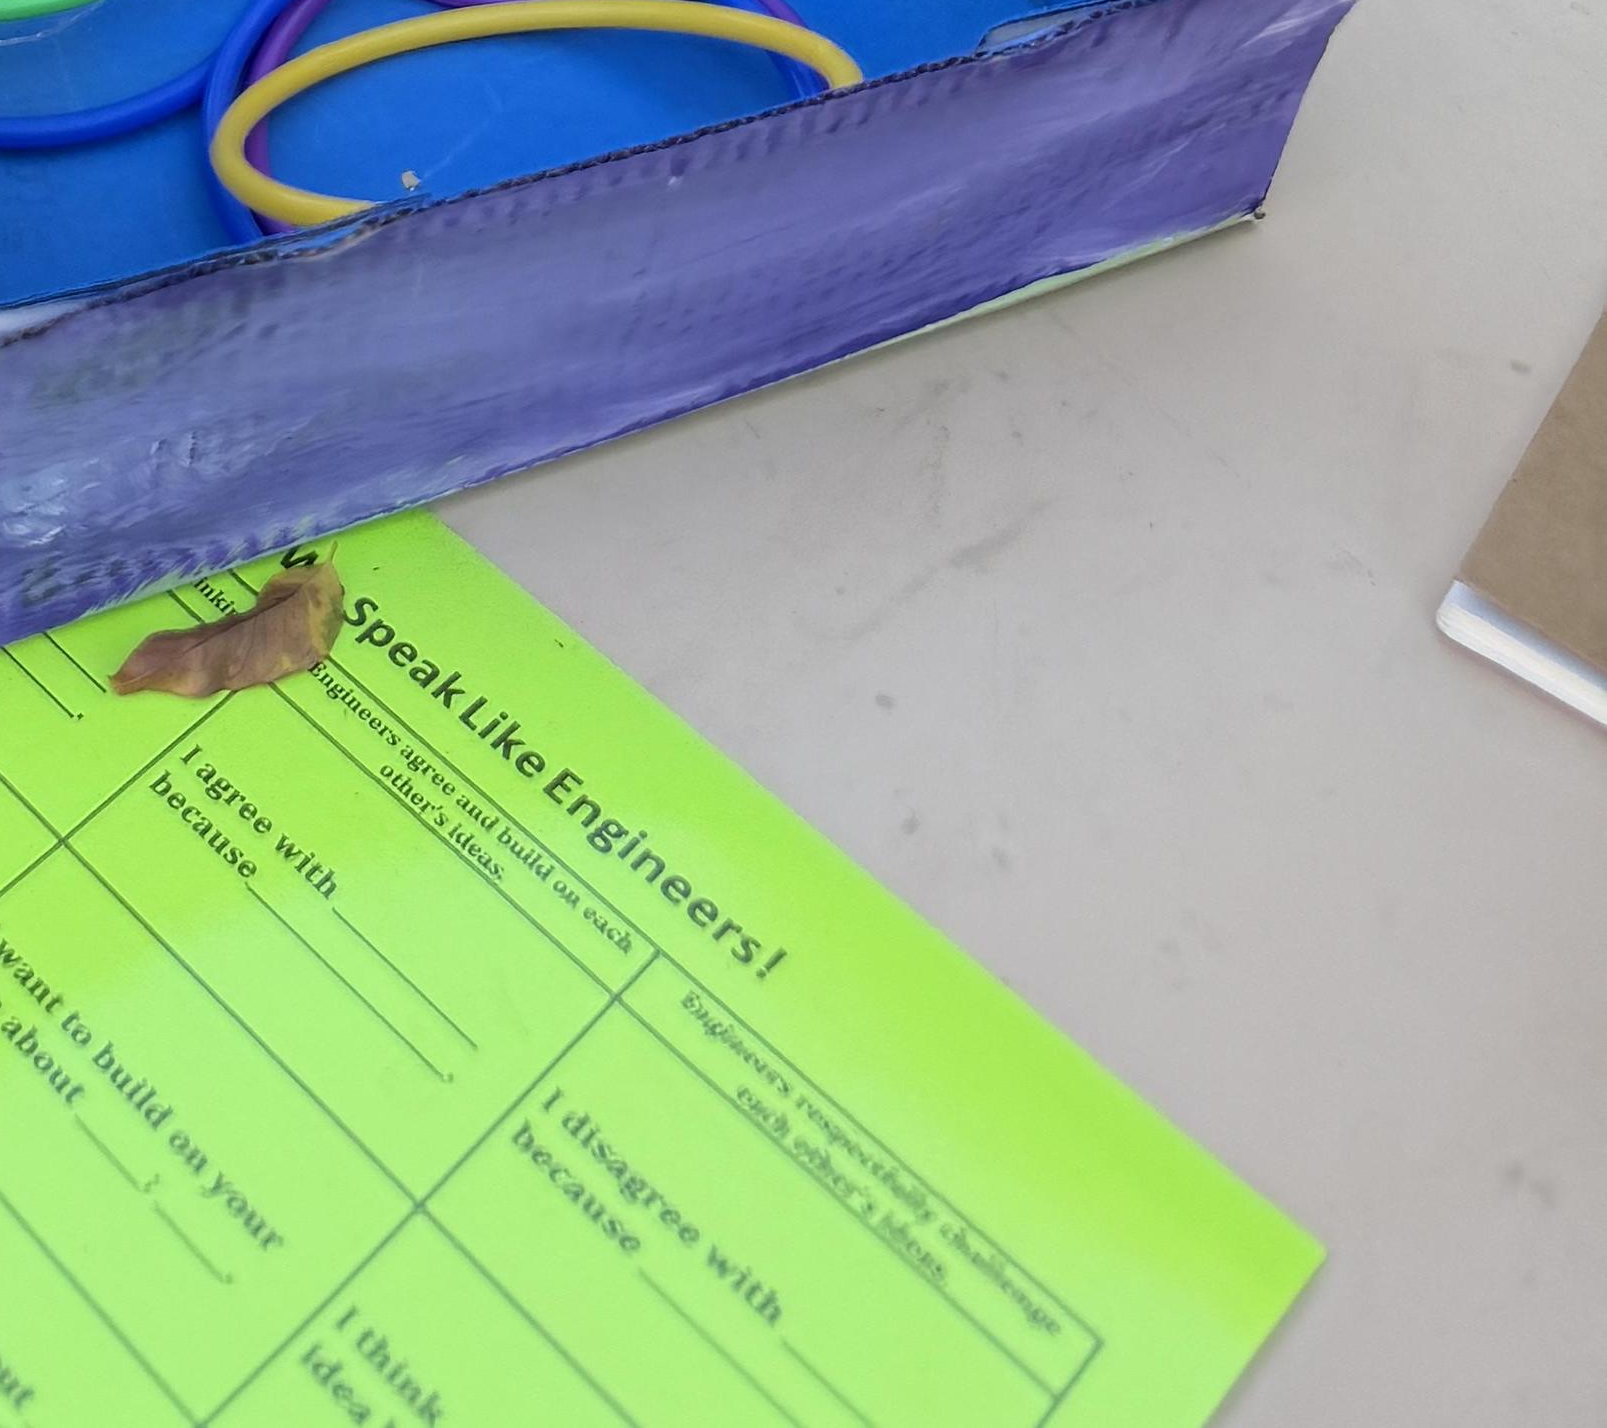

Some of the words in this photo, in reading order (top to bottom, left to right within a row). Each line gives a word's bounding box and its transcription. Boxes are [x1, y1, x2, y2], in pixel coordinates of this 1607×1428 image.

[178, 742, 204, 767] I
[194, 762, 274, 835] agree
[273, 833, 338, 902] with
[306, 658, 403, 748] Engineers
[398, 743, 457, 797] agree
[454, 793, 501, 834] and
[495, 824, 557, 884] build
[551, 879, 582, 911] on
[581, 906, 633, 957] each
[333, 596, 467, 711] Speak
[457, 694, 547, 780] Like
[540, 766, 789, 981] Engineers!
[378, 764, 450, 829] other's
[0, 1014, 86, 1106] about
[59, 1011, 93, 1048] to
[90, 1039, 175, 1133] build
[167, 1129, 209, 1178] on
[200, 1170, 285, 1253] your
[509, 1117, 643, 1257] because
[540, 1086, 565, 1114] I
[560, 1110, 701, 1246] disagree
[705, 1243, 783, 1329] with
[354, 1326, 444, 1428] think
